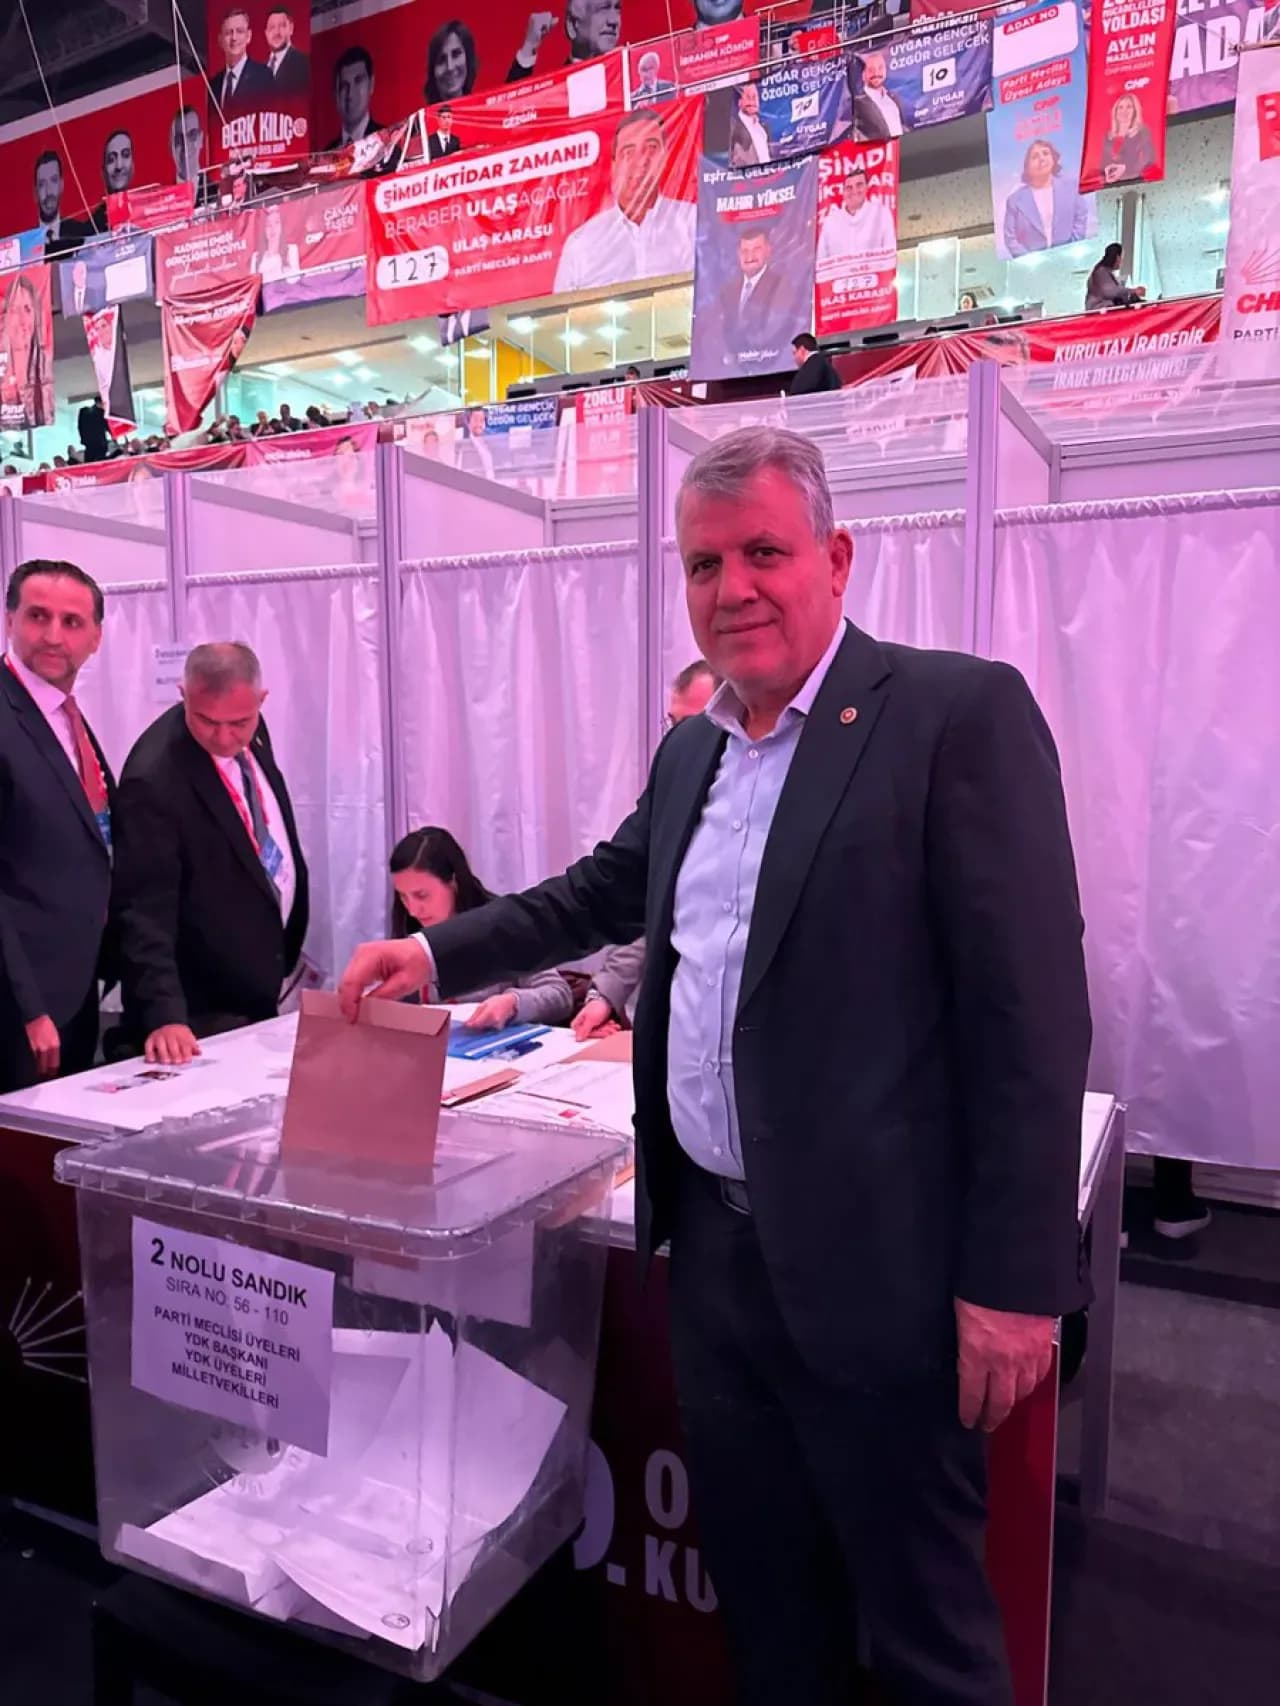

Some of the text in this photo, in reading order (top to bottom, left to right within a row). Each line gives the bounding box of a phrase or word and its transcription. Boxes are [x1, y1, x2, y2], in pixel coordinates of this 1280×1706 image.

[1006, 9, 1057, 33] ADAY NO
[1103, 6, 1166, 34] YOLDAŞI
[889, 33, 990, 70] ÖZGÜR GELECEK
[890, 36, 931, 56] UYGAR
[761, 69, 798, 86] UYGAR
[761, 83, 799, 101] ÖZGÜR
[930, 68, 948, 87] 10
[933, 90, 965, 105] UYGAR
[222, 111, 293, 150] BERK KILIÇ
[383, 142, 590, 209] ŞİMDİ İKTİDAR ZAMANI!
[385, 204, 462, 239] BERABER
[453, 223, 553, 253] ULAŞ KARASU
[388, 252, 438, 283] 127
[1236, 292, 1280, 314] CH
[1053, 326, 1205, 363] KURULTAY İRADEDİR
[1052, 367, 1090, 391] İRADE
[584, 387, 625, 409] ZORLU
[150, 1238, 308, 1308] 2 NOLU SANDIK
[166, 1276, 201, 1297] SIRA
[234, 1296, 250, 1314] 56
[265, 1306, 289, 1326] 110
[154, 1305, 300, 1362] PARTİ MECLİSİ ÜYELERİ
[185, 1332, 268, 1370] YDK BAŞKANI
[185, 1349, 267, 1387] YDK ÜYELERİ
[172, 1362, 279, 1409] MİLLETVEKİLLERİ
